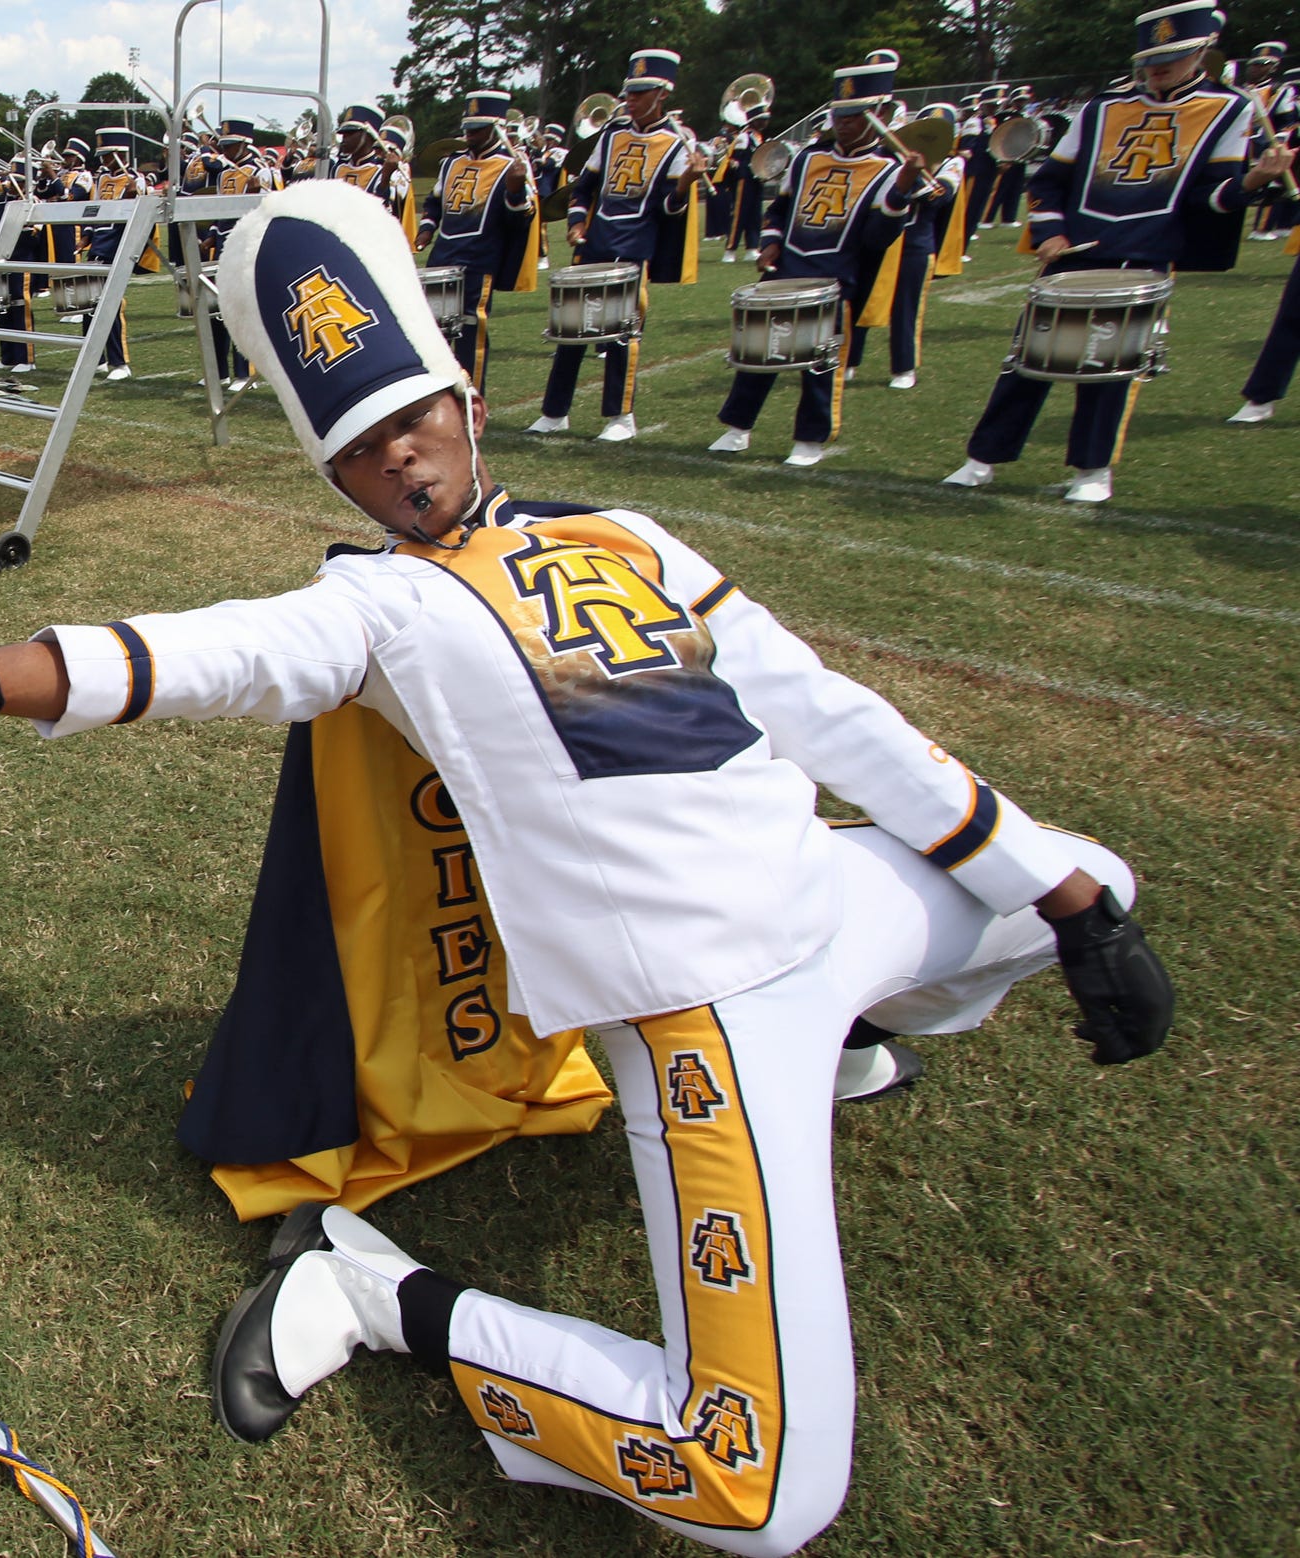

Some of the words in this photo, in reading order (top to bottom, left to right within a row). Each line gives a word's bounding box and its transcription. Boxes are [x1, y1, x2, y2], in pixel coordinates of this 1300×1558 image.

[582, 293, 604, 333] Pearl
[768, 316, 793, 360] Pearl
[1083, 314, 1118, 368] Pearl
